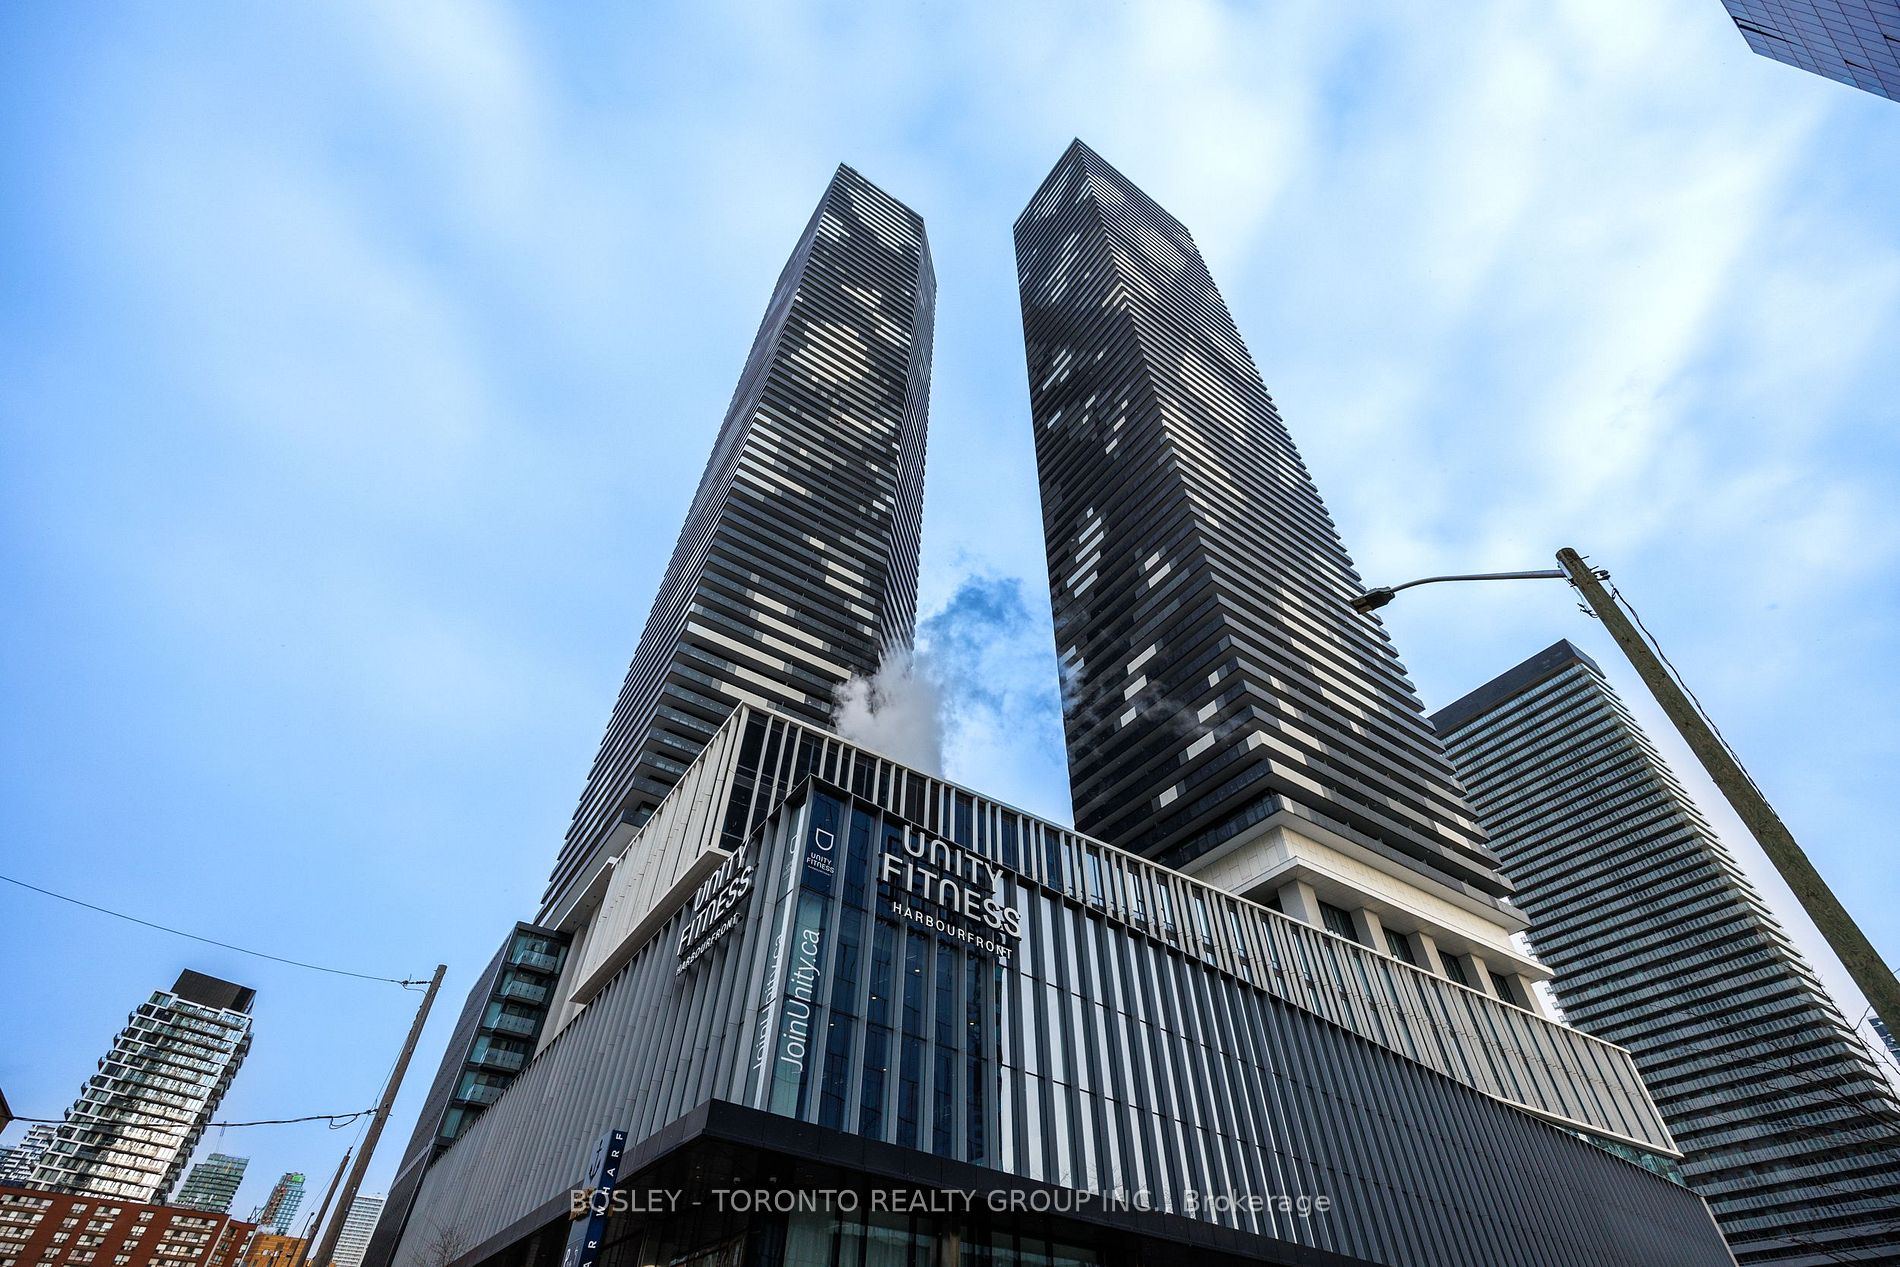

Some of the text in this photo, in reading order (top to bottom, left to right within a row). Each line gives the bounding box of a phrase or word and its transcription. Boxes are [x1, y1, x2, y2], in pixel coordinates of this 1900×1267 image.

[882, 853, 1022, 939] FITNESS
[904, 825, 1004, 893] UNITY
[893, 901, 1013, 960] HARBOURFRONT
[780, 929, 821, 1072] JoinUnity.ca
